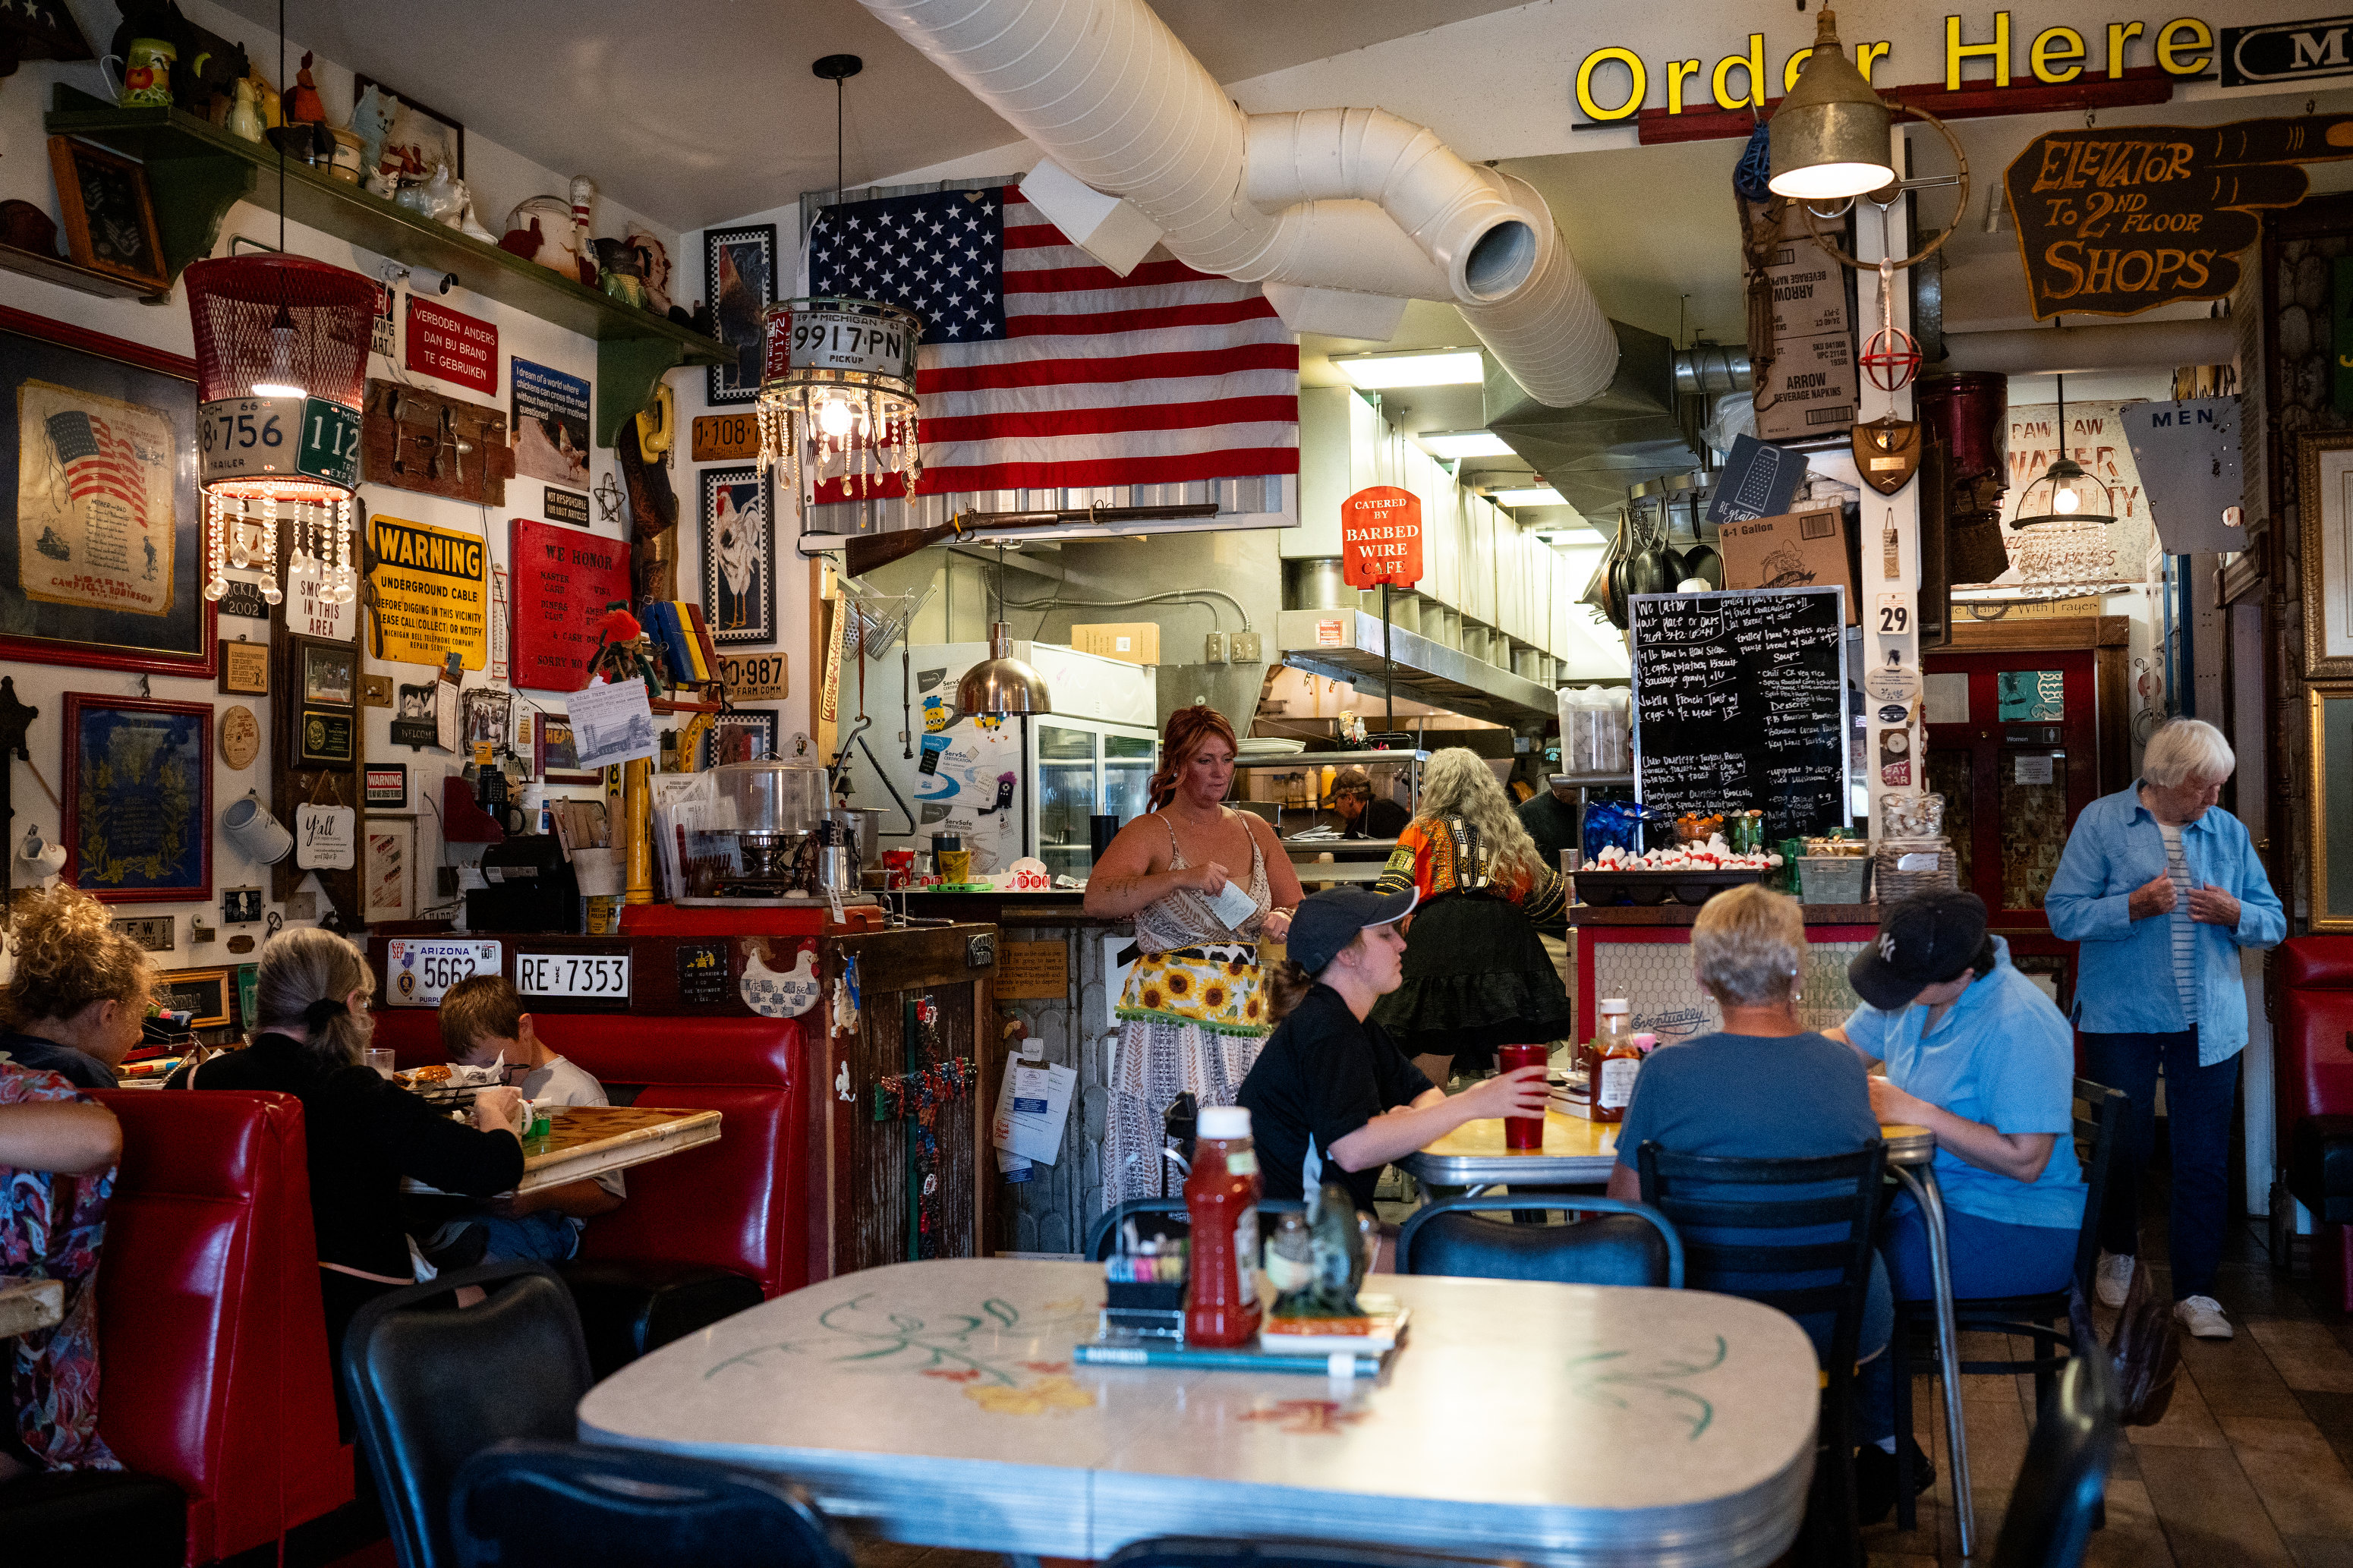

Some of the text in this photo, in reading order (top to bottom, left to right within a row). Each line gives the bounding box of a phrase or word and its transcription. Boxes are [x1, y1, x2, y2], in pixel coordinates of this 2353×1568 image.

[1945, 11, 2214, 91] Here
[2031, 140, 2194, 193] ELEVATOR
[2045, 191, 2203, 238] To 2ND FLOOR
[1791, 271, 1826, 284] BEVERAGE
[2041, 241, 2217, 299] SHOPS
[1774, 284, 1814, 302] ARROW
[415, 307, 496, 345] VERBODEN ANDERS
[820, 313, 877, 326] MICHIGAN
[424, 331, 443, 347] DAN
[459, 342, 487, 361] BRAND
[1813, 342, 1824, 351] SKU
[424, 351, 487, 380] TE GEBRUIKEN
[830, 354, 864, 364] PICKUP
[519, 367, 579, 395] dream of world where
[1787, 372, 1826, 390] ARROW
[516, 379, 587, 409] chickens can cross the road
[1774, 386, 1841, 403] BEVERAGE NAPKINS
[241, 401, 258, 411] 66
[516, 391, 587, 420] without having their motives
[519, 405, 549, 420] questioned
[2152, 408, 2213, 428] MEN
[91, 499, 111, 509] MOTHER
[547, 491, 587, 510] NOT RESPONSIBLE
[1355, 498, 1406, 510] CATERED
[1718, 501, 1731, 515] BE
[547, 503, 587, 522] FOR LOST ARTICLES
[1374, 510, 1389, 520] BY
[1346, 524, 1419, 542] BARBED
[1741, 523, 1773, 534] Gallon
[377, 525, 480, 577] WARNING
[546, 544, 613, 570] WE HONOR
[1359, 543, 1408, 559] WIRE
[1361, 560, 1406, 575] CAFE
[540, 571, 569, 584] MASTER
[381, 575, 477, 602] UNDERGROUND CABLE
[544, 584, 565, 594] CARD
[594, 586, 612, 597] VISA
[228, 601, 259, 616] 2002
[304, 599, 340, 619] IN THIS
[377, 598, 482, 623] BEFORE DIGGING IN THIS VICINITY
[541, 600, 568, 612] DINERS
[2014, 602, 2048, 614] With
[544, 611, 563, 622] CLUB
[1663, 617, 1684, 632] place
[1880, 607, 1907, 632] 29
[309, 619, 334, 637] AREA
[380, 612, 399, 625] LEASE
[402, 616, 415, 628] CALL
[449, 623, 458, 634] OR
[460, 625, 483, 638] NOTIFY
[384, 629, 474, 648] MICHIGAN BELL TELEPHONE COMPANY
[411, 641, 429, 650] REPAIR
[562, 632, 582, 643] CASH
[537, 656, 582, 669] SORRY NO
[1773, 651, 1800, 663] Soups
[1644, 673, 1707, 688] sausage gravy
[737, 685, 782, 696] FARM COMM
[368, 774, 402, 786] WARNING
[306, 814, 335, 847] Y'all
[421, 946, 471, 956] ARIZONA
[521, 959, 550, 991] RE
[566, 959, 623, 992] 7353
[745, 980, 779, 994] Kitchen
[1632, 1007, 1706, 1032] Eventually
